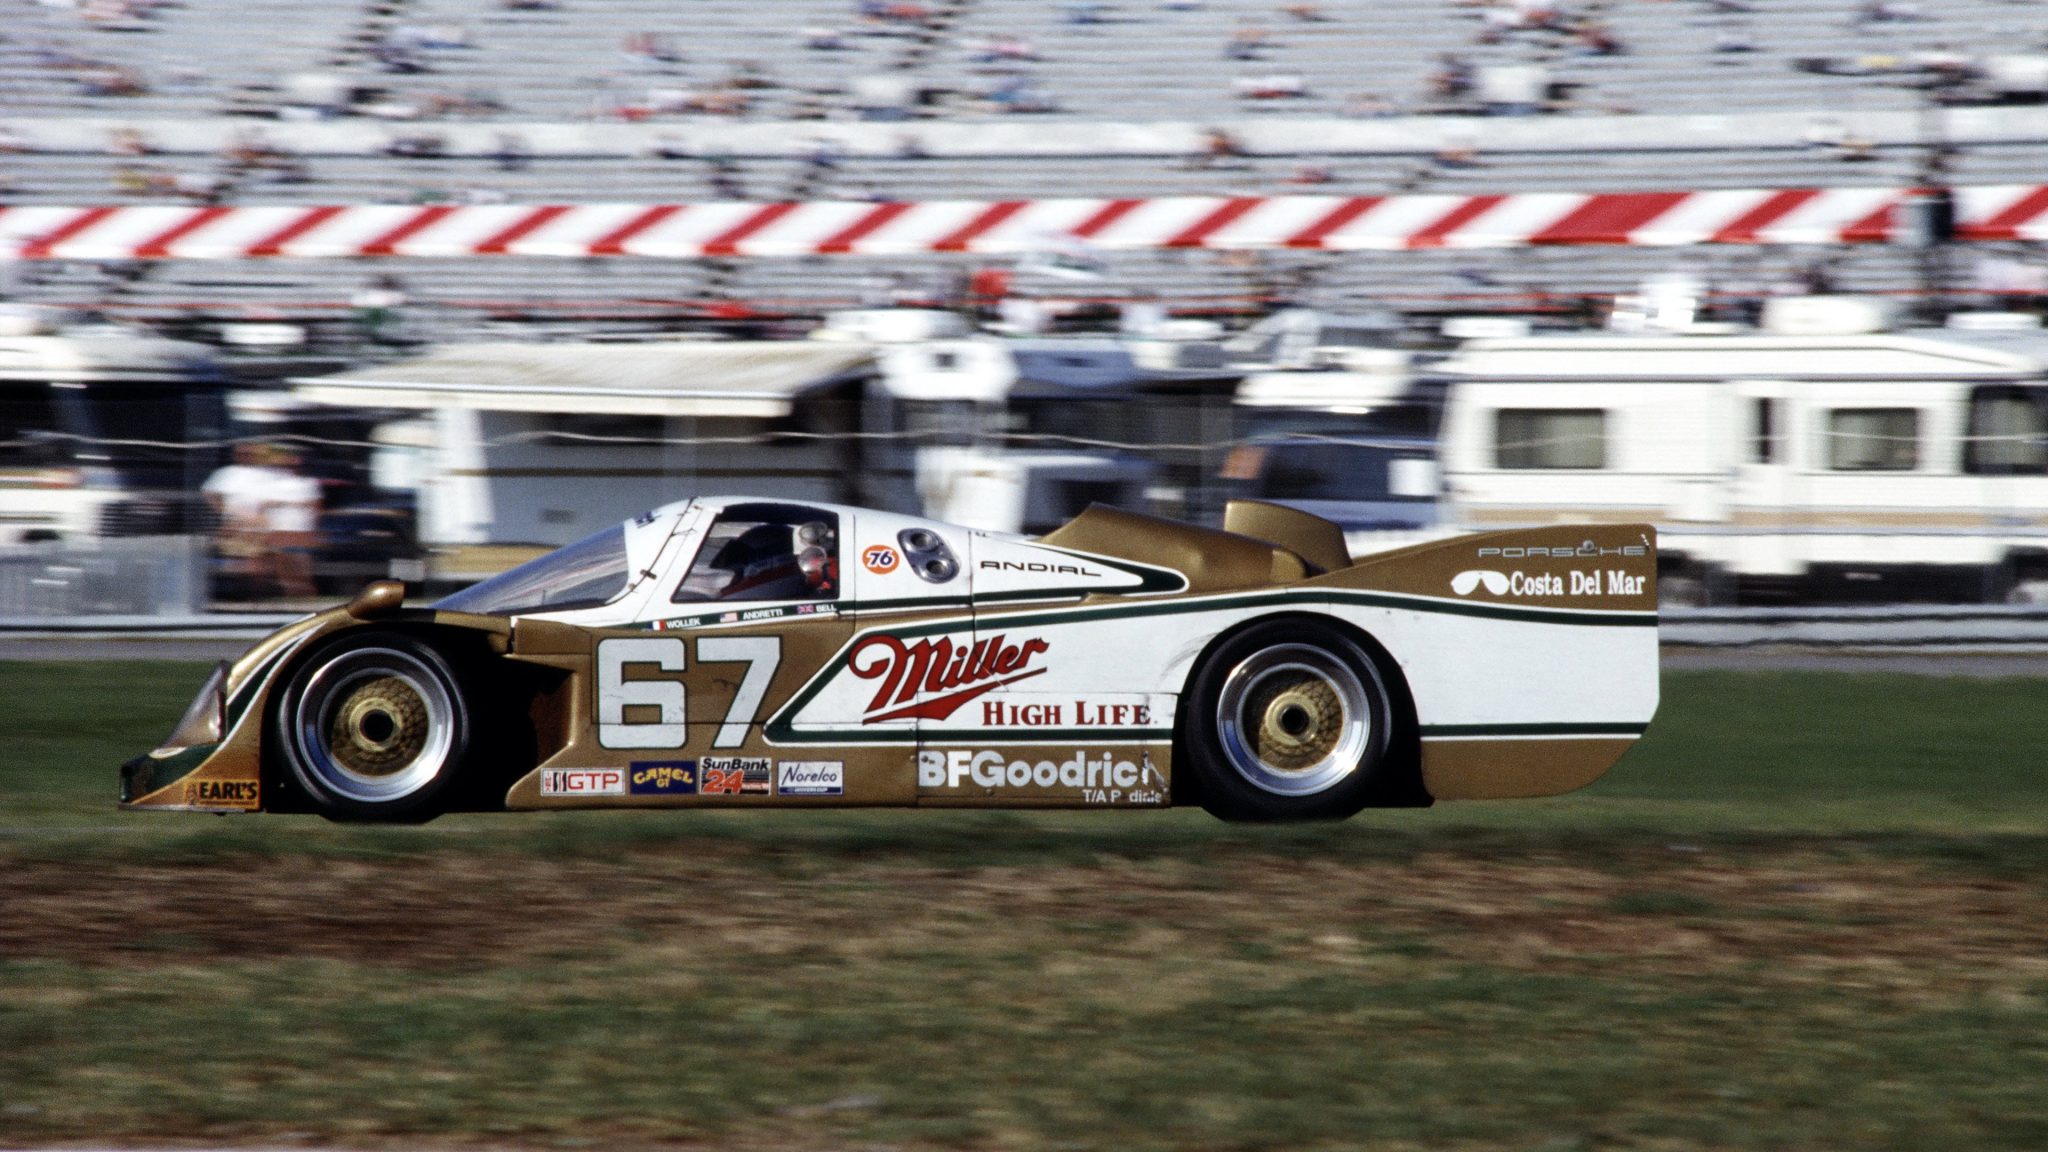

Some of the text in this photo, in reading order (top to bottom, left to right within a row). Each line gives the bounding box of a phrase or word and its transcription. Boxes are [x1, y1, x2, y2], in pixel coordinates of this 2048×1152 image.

[868, 550, 894, 567] 76
[1478, 545, 1646, 558] PORSCHE
[980, 560, 1102, 577] ANDIAL
[1510, 569, 1646, 596] Costa Del Mar
[742, 607, 784, 621] ANDRETTI
[816, 603, 837, 613] BELL
[666, 617, 701, 630] WOLLEK
[849, 634, 1050, 716] Miller
[598, 636, 782, 749] 67
[982, 701, 1151, 726] HIGH LIFE
[702, 757, 769, 770] SunBank
[567, 773, 620, 791] GTP
[633, 767, 694, 785] CAMEL
[703, 768, 745, 794] 24
[781, 763, 837, 786] Norelco
[199, 781, 258, 800] EARL'S
[1082, 789, 1107, 803] T/A
